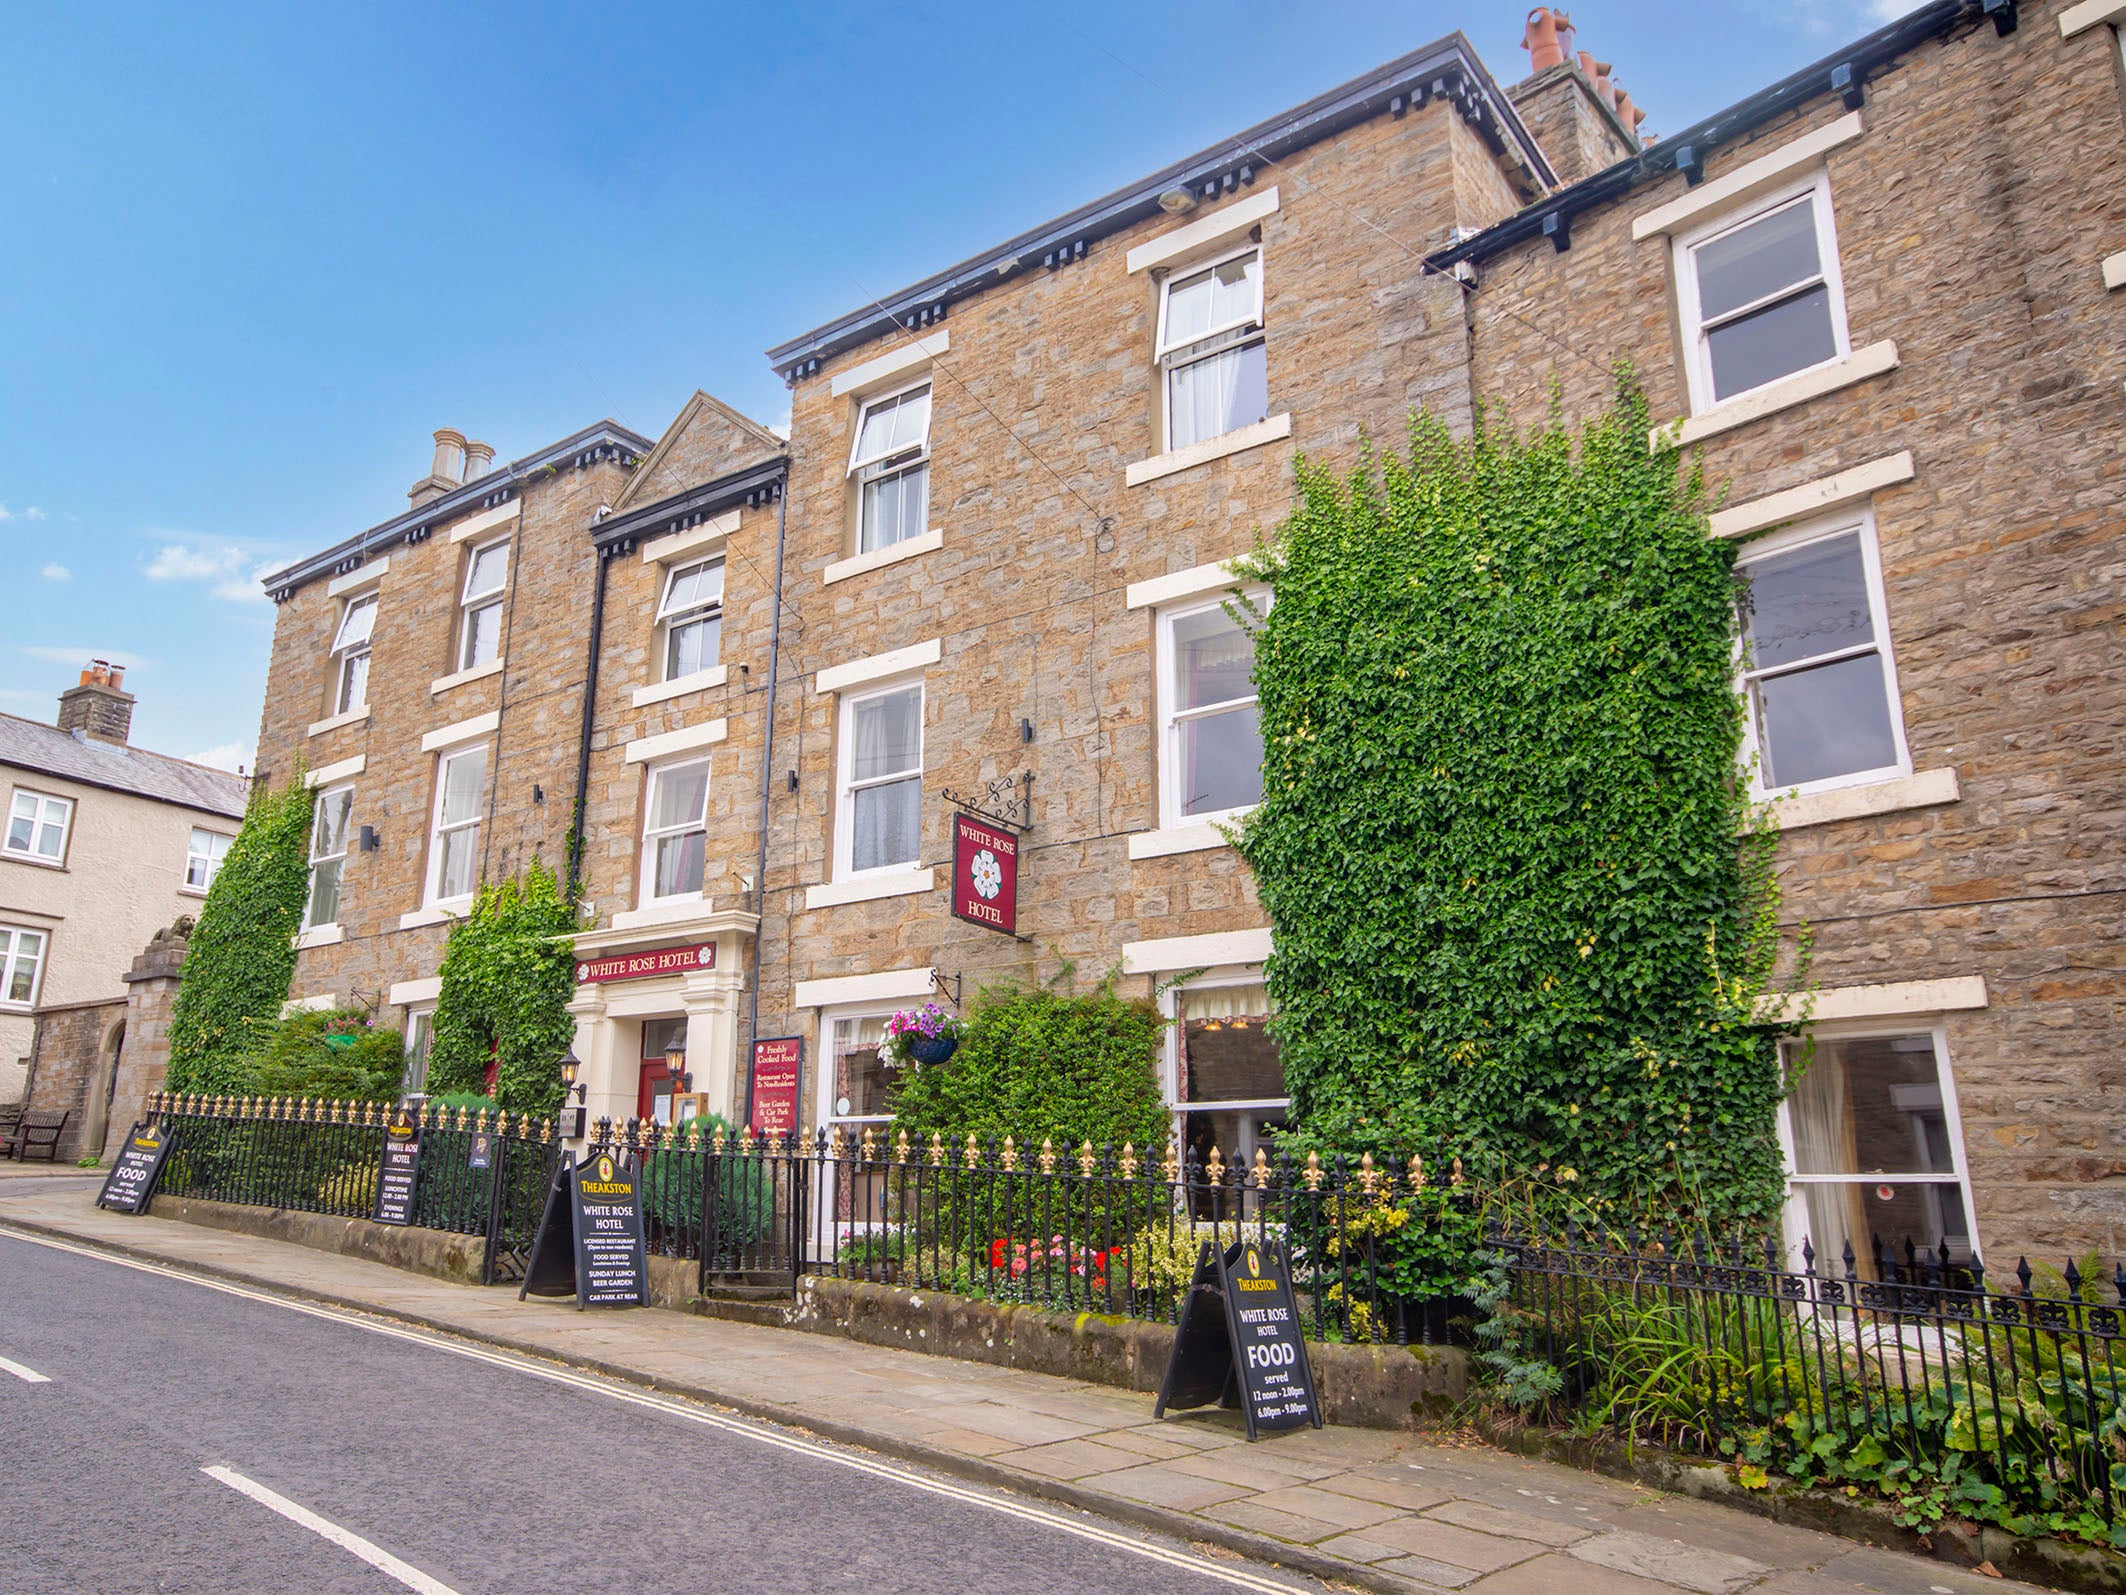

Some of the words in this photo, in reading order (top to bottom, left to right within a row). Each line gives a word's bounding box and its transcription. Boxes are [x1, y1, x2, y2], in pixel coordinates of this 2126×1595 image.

[960, 824, 991, 847] WHITE
[993, 837, 1015, 855] ROSE
[968, 900, 1003, 924] HOTEL
[590, 961, 626, 977] WHITE
[629, 957, 656, 972] ROSE
[659, 951, 696, 969] HOTEL
[767, 1045, 788, 1055] Freshly
[758, 1055, 779, 1063] Cooked
[781, 1053, 796, 1062] Food
[782, 1073, 795, 1081] Open
[759, 1100, 770, 1108] Beer
[387, 1143, 404, 1151] WHITE
[125, 1152, 141, 1160] WHITE
[141, 1155, 156, 1163] ROSE
[392, 1155, 410, 1164] HOTEL
[116, 1167, 146, 1181] FOOD
[581, 1180, 631, 1194] THEAKSTON
[583, 1206, 610, 1216] WHITE
[612, 1206, 633, 1216] ROSE
[596, 1219, 623, 1229] HOTEL
[1237, 1278, 1277, 1291] THEAKSTON
[1240, 1308, 1267, 1323] WHITE
[1269, 1308, 1289, 1321] ROSE
[1257, 1325, 1278, 1337] HOTEL
[1247, 1343, 1295, 1369] FOOD
[1265, 1371, 1289, 1384] served
[1253, 1391, 1261, 1401] 12
[1262, 1391, 1278, 1400] noon
[1282, 1387, 1304, 1400] 2.00pm
[1257, 1406, 1281, 1419] 6.00pm
[1285, 1403, 1307, 1417] 9.00pm
